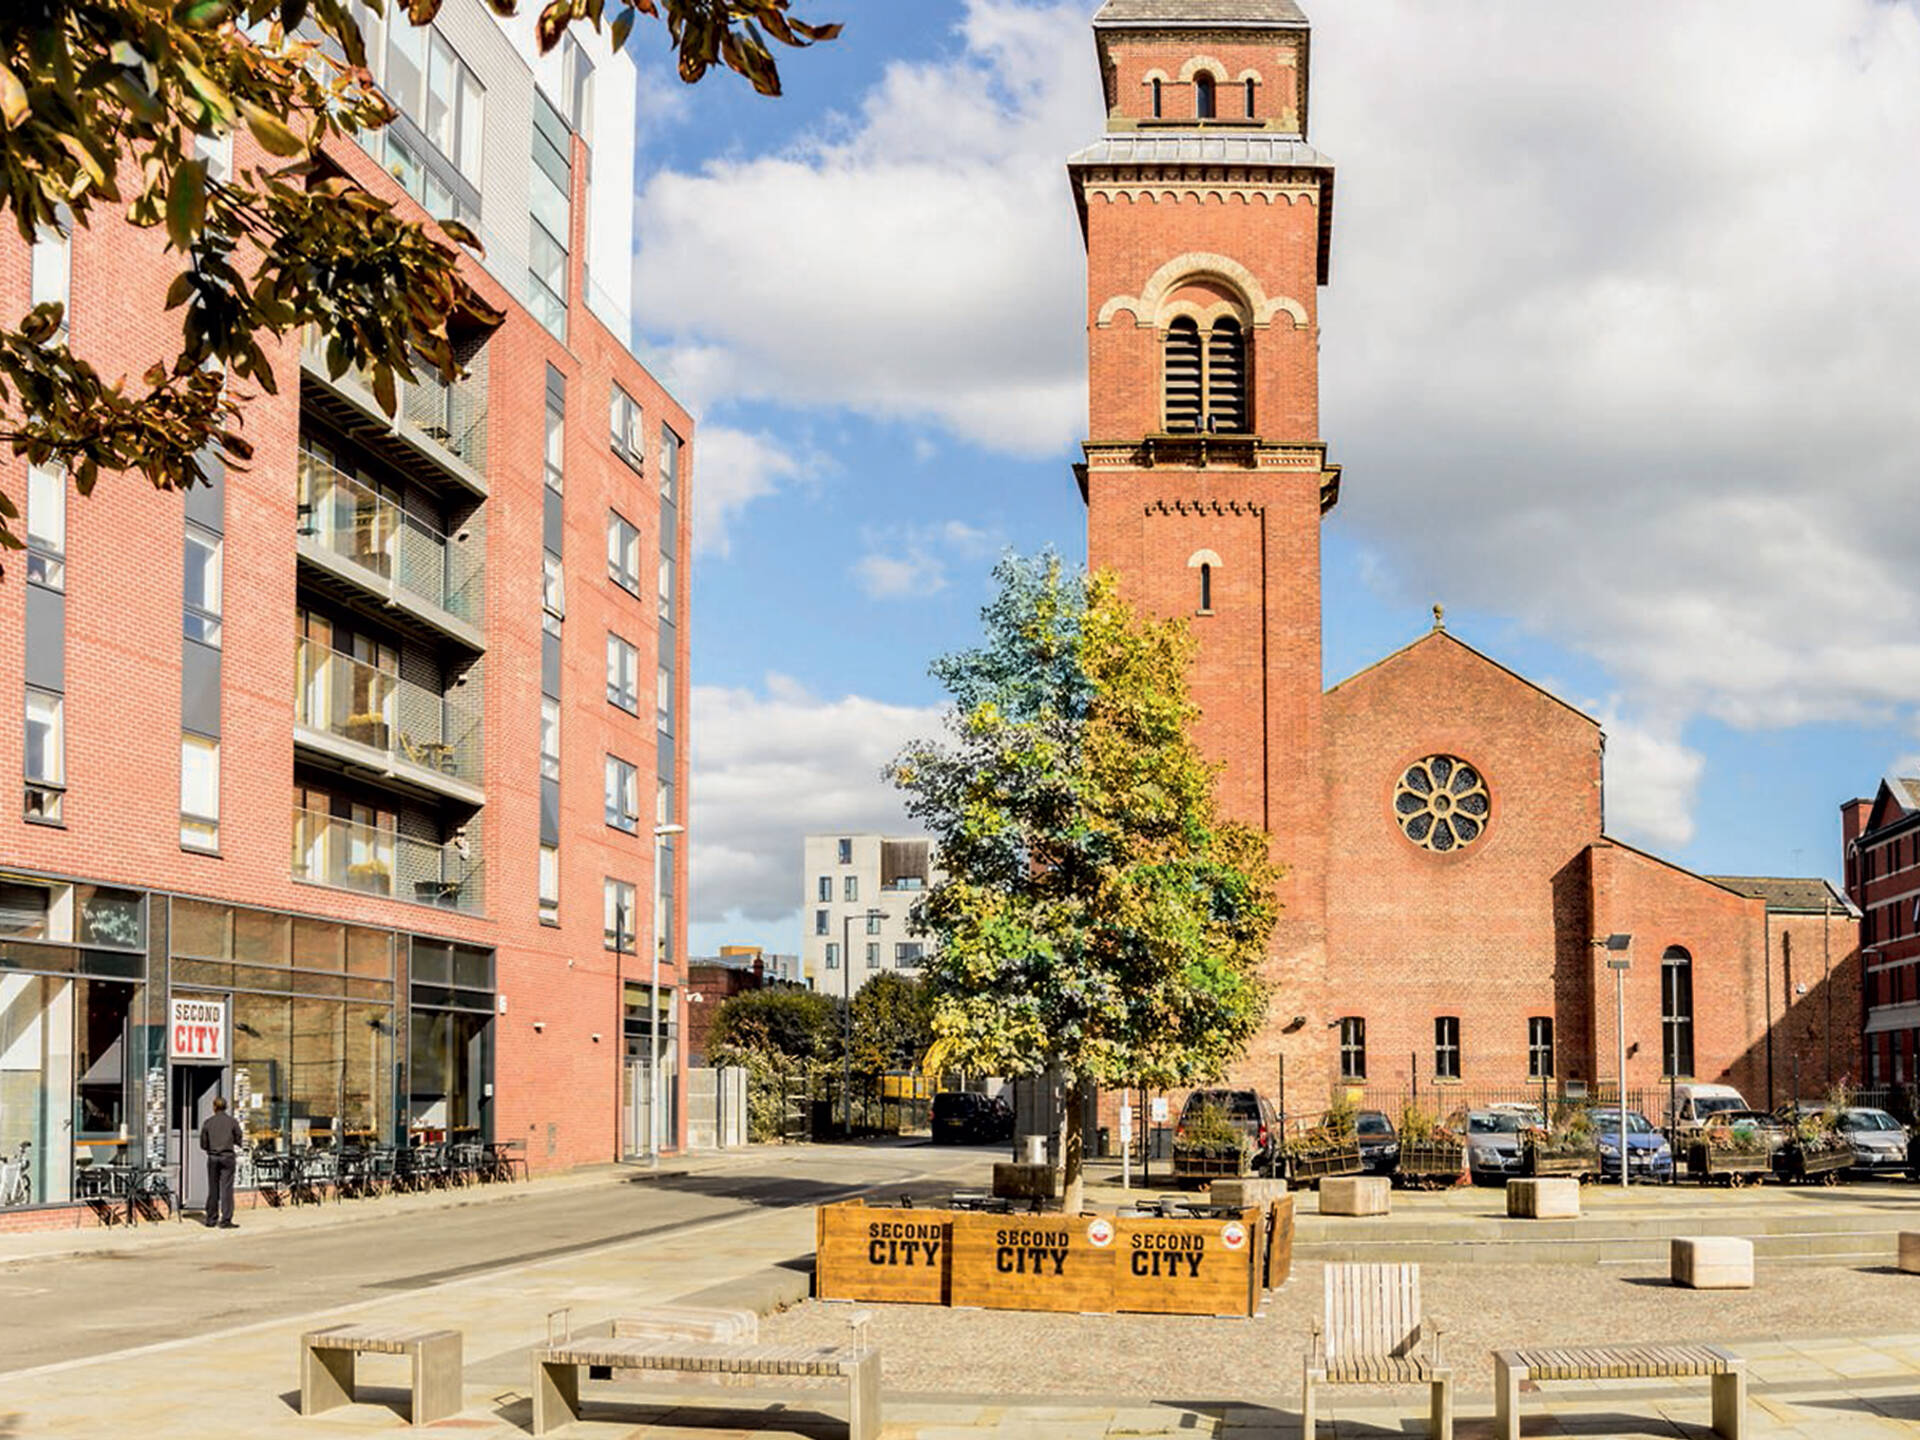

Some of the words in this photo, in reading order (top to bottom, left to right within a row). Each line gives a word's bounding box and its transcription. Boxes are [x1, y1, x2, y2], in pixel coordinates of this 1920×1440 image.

[175, 1003, 220, 1022] SECOND
[175, 1025, 219, 1054] CITY
[869, 1222, 940, 1239] SECOND
[996, 1230, 1069, 1247] SECOND
[1131, 1233, 1204, 1250] SECOND
[869, 1240, 940, 1266] CITY
[996, 1247, 1069, 1275] CITY
[1131, 1250, 1204, 1277] CITY
